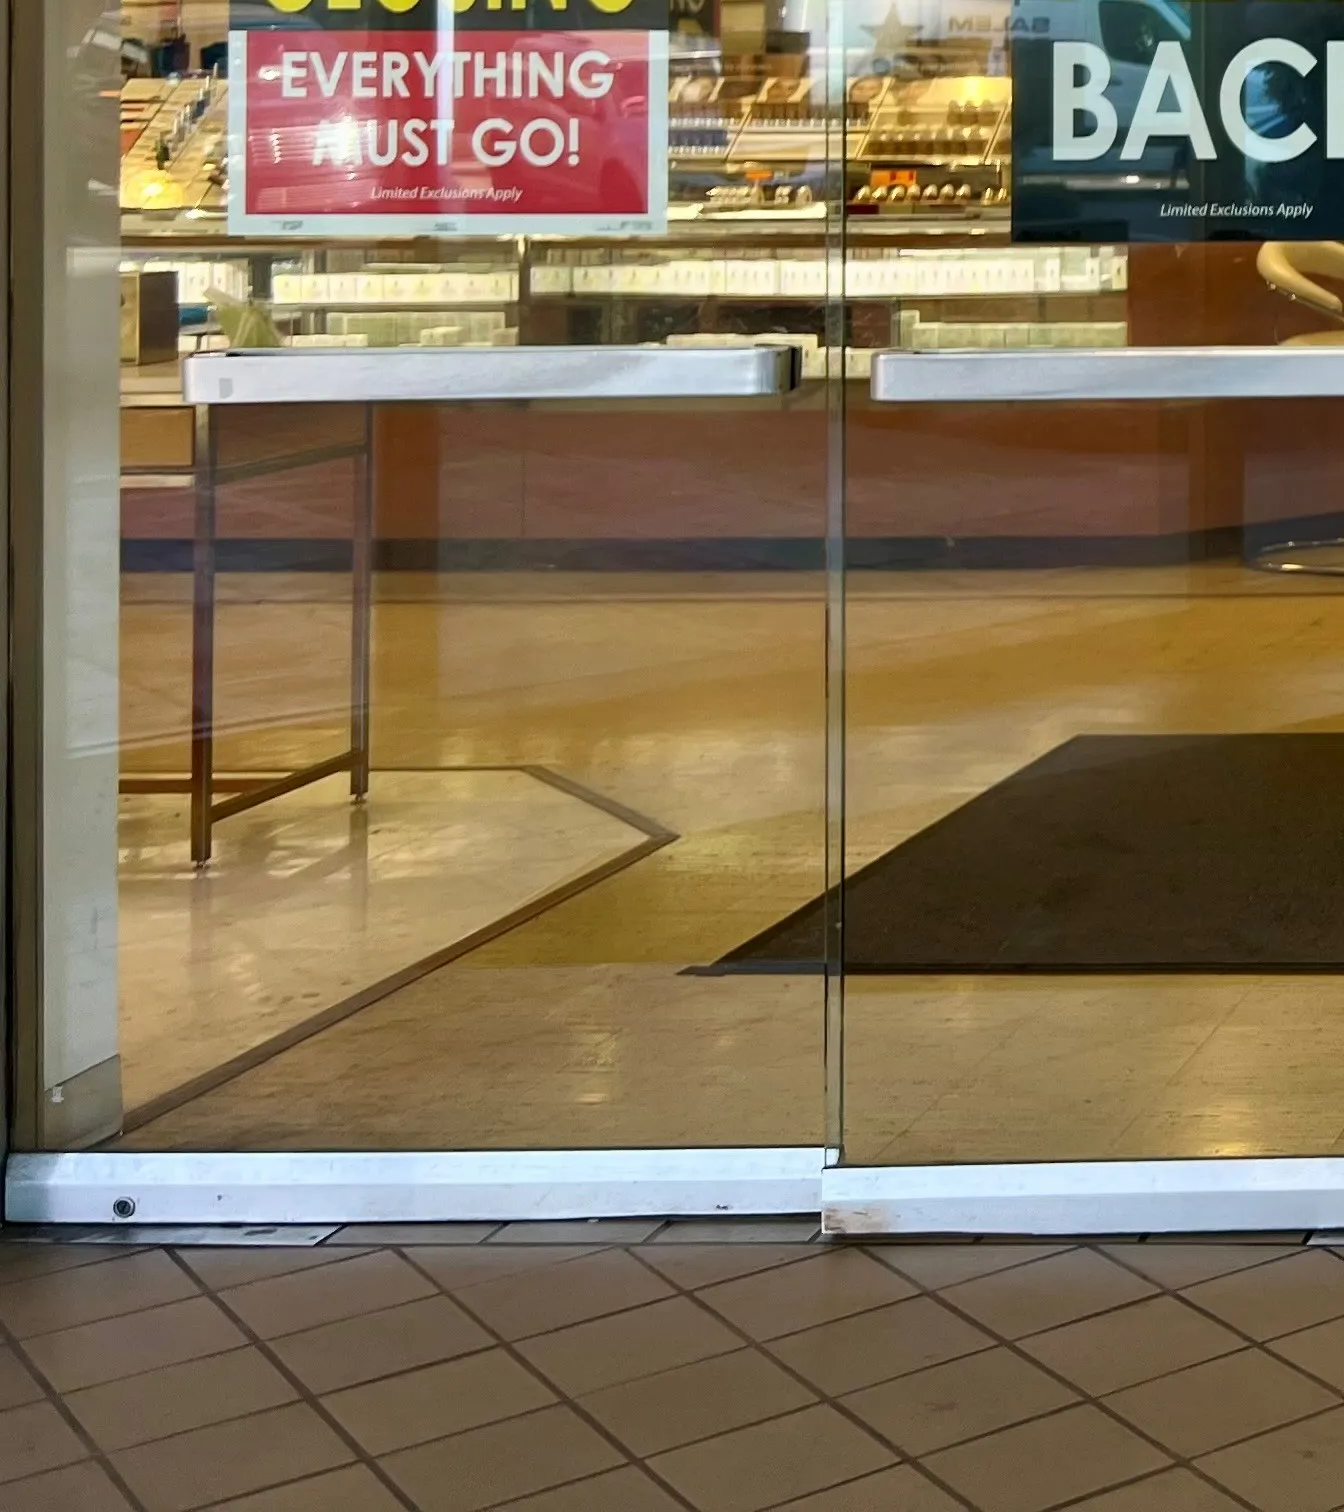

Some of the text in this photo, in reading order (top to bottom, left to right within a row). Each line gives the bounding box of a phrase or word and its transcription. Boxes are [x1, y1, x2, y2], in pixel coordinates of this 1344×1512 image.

[281, 50, 616, 100] EVERYTHING
[472, 117, 582, 168] GO!
[370, 185, 524, 204] Limited Exclusions Apply
[1160, 201, 1314, 221] Limited Exclusions Apply
